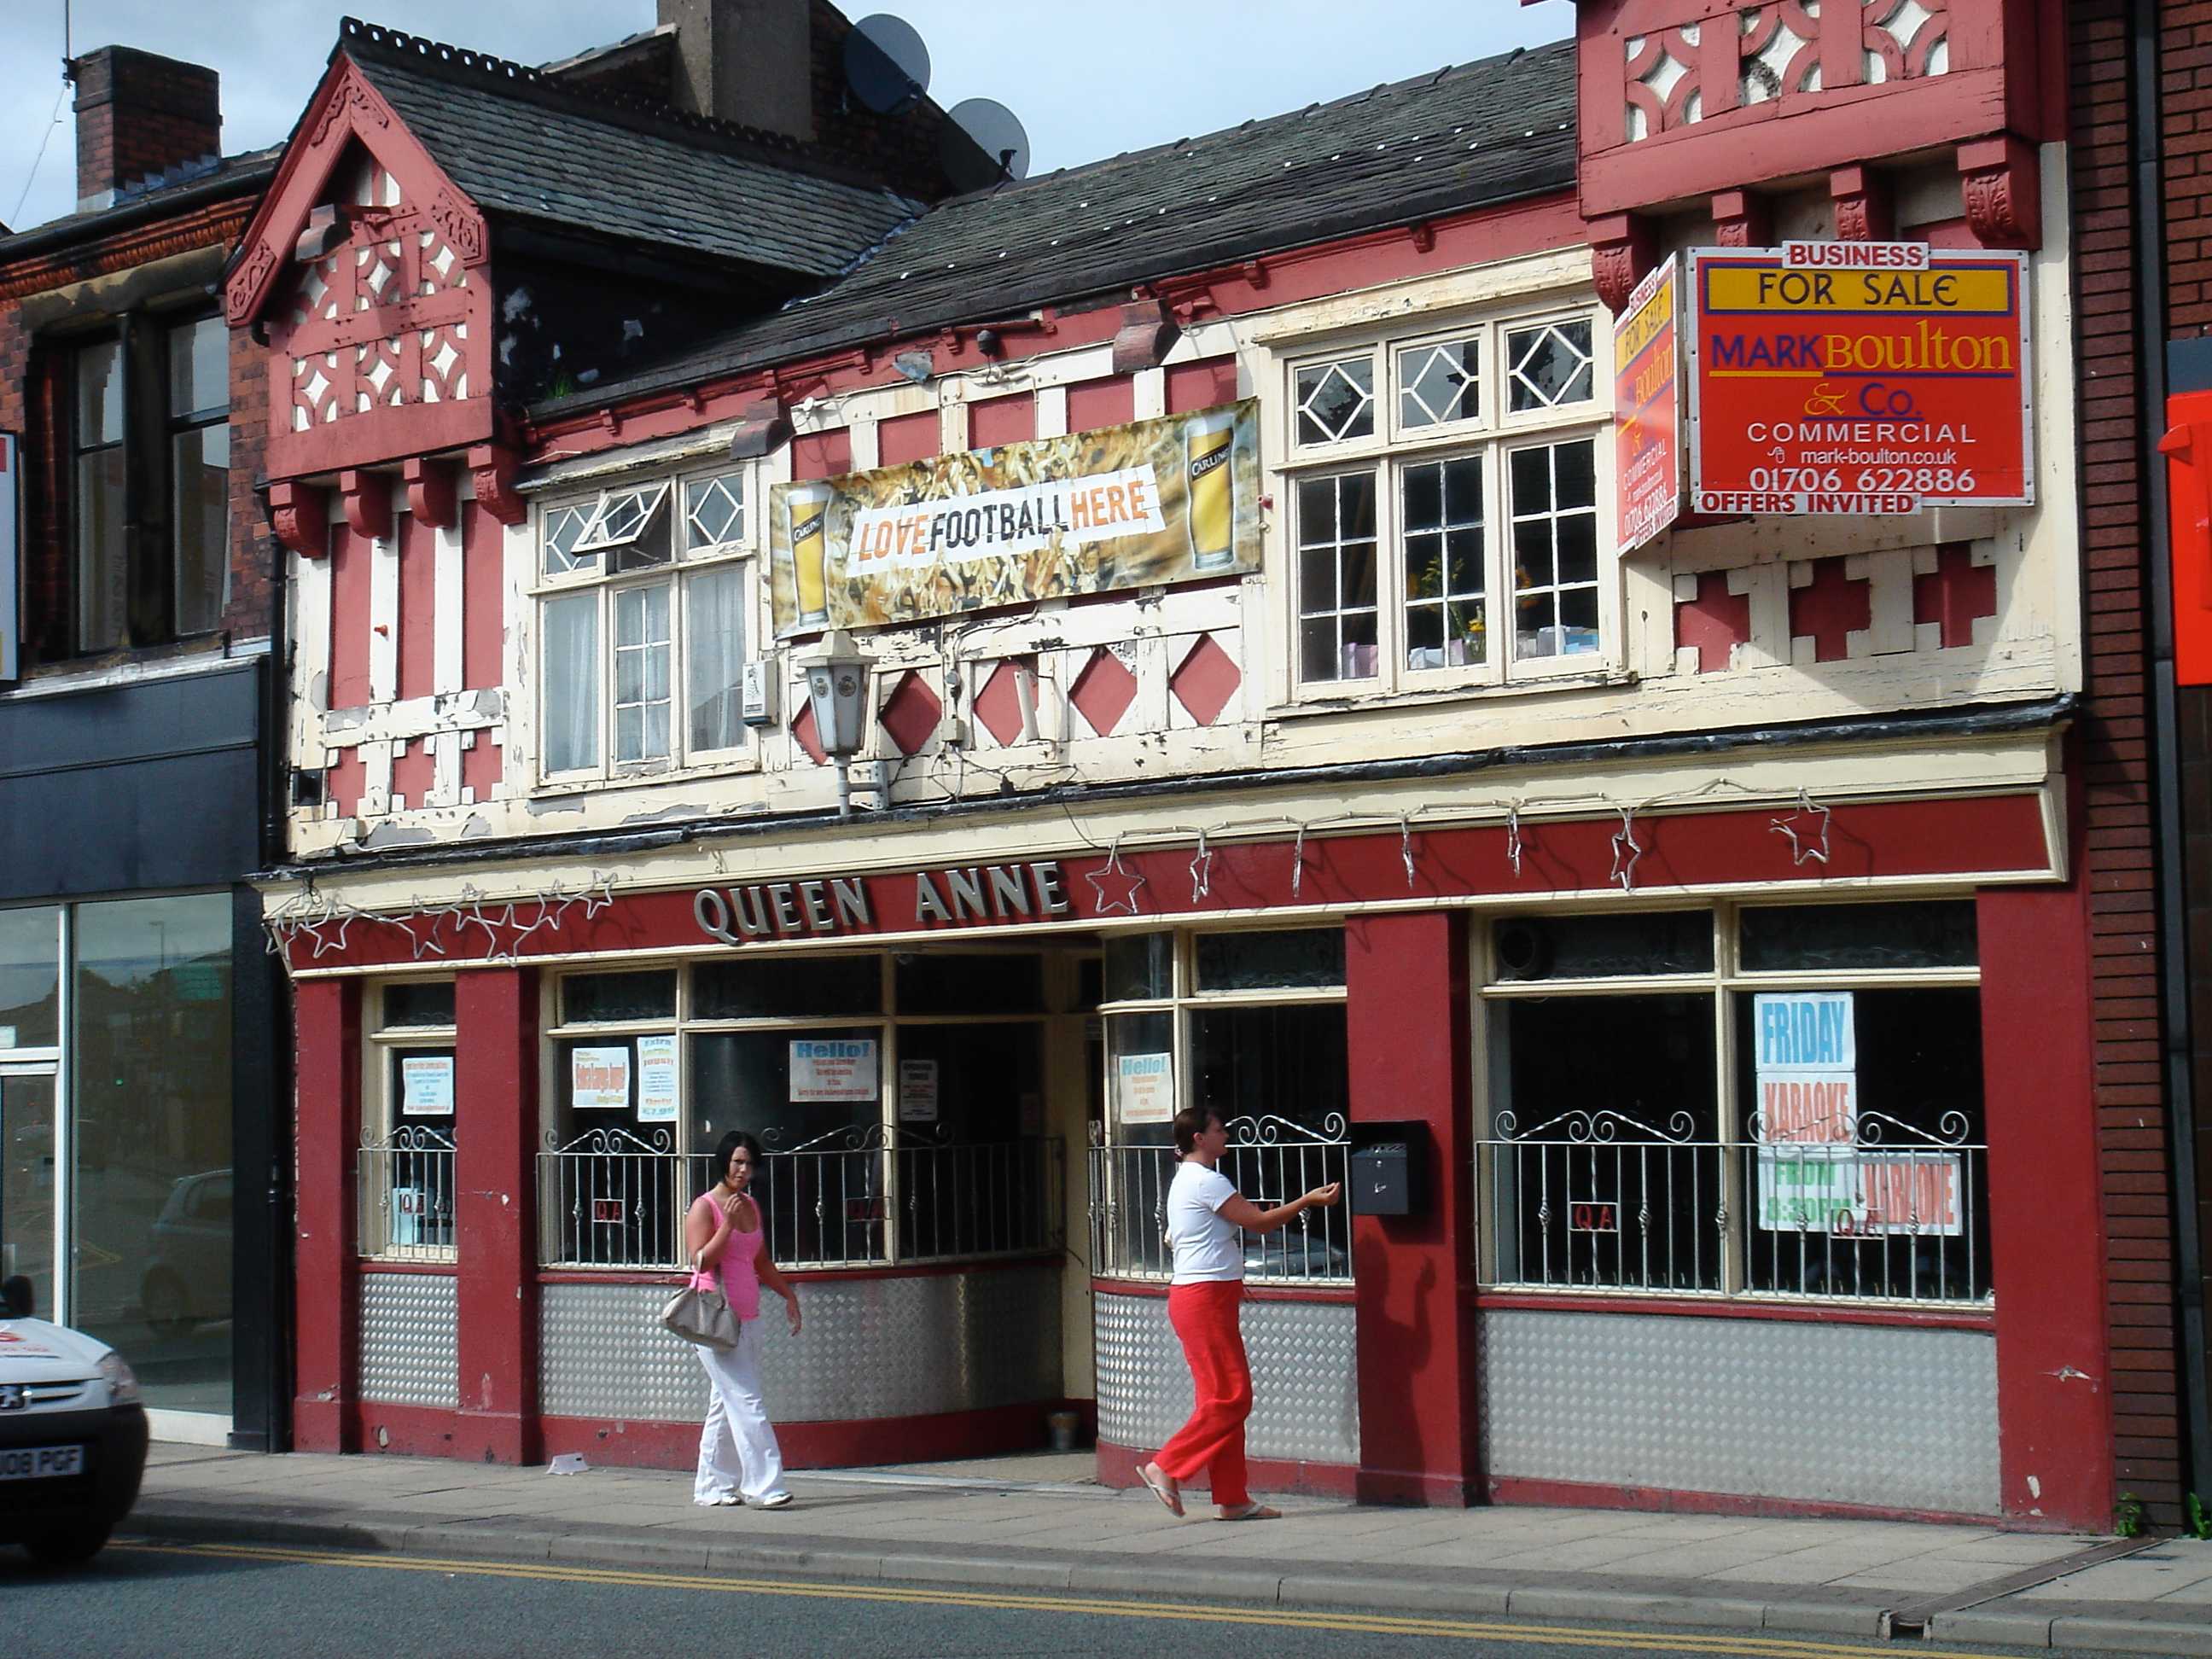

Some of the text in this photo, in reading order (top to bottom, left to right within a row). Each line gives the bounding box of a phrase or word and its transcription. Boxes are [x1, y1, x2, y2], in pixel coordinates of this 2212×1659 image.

[1790, 245, 1923, 266] BUSINESS
[1759, 273, 1958, 306] FOR SALE
[1803, 382, 1848, 416] &
[1747, 423, 1976, 443] COMMERCIAL
[1801, 448, 1957, 465] mark-boulton.co.uk
[1749, 468, 1976, 492] 01706 622886
[1701, 492, 1914, 514] OFFERS INVITED
[695, 861, 1068, 946] QUEEN ANNE
[1761, 1002, 1845, 1063] FRIDAY
[796, 1042, 870, 1058] Hello!
[1122, 1057, 1167, 1075] Hello!
[1764, 1081, 1849, 1142] KARAOKE
